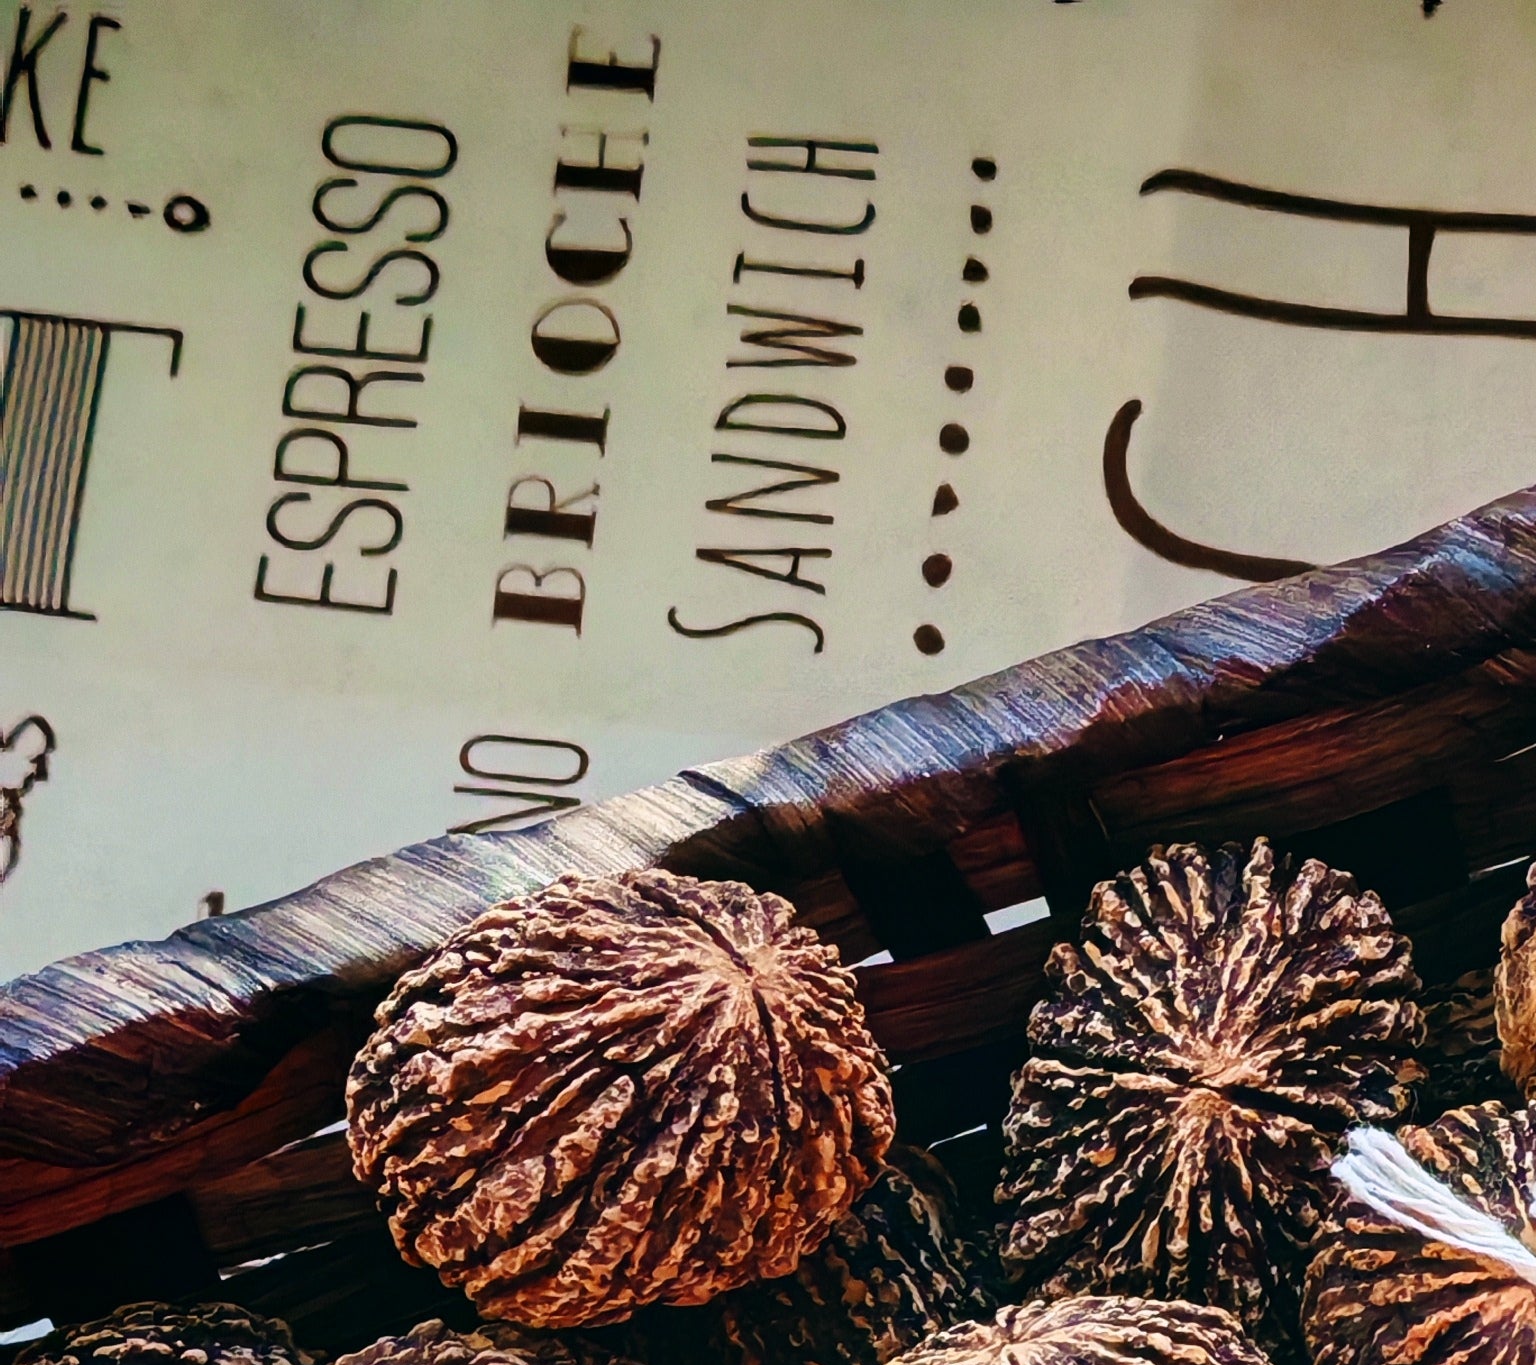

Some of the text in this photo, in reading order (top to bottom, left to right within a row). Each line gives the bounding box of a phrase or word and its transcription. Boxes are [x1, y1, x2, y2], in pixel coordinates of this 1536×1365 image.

[253, 114, 458, 616] ESPRESSO
[492, 25, 662, 638] BRIOCHE
[667, 136, 881, 655] SANDWICH
